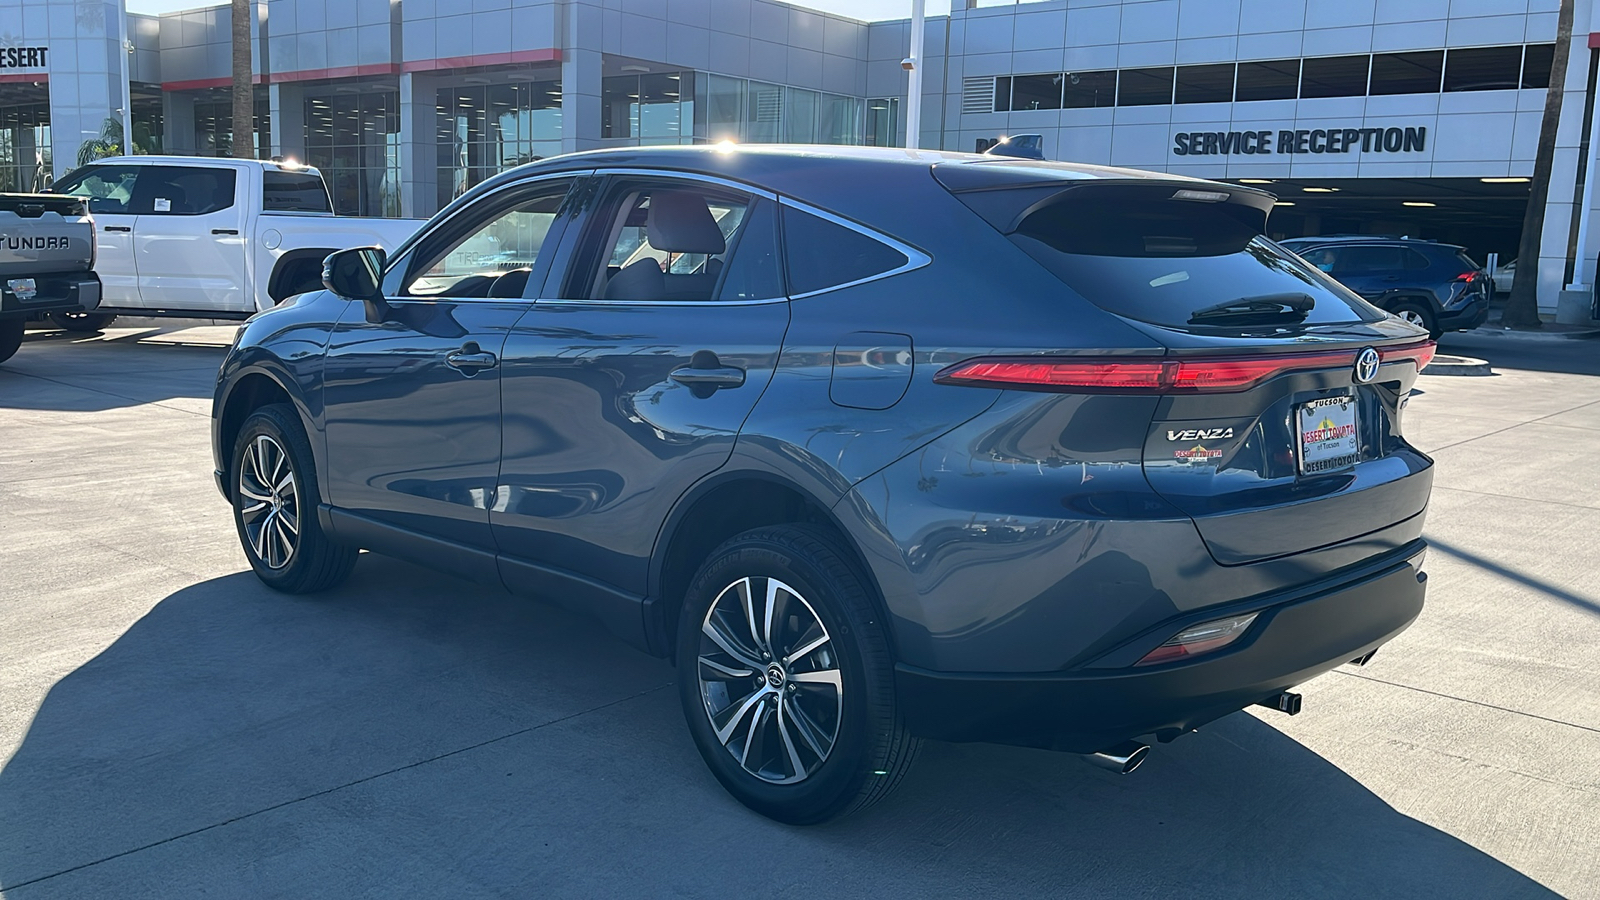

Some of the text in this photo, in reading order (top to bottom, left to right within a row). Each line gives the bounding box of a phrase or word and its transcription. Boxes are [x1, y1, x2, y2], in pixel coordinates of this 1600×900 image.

[0, 47, 48, 68] ESERT
[1173, 126, 1426, 156] SERVICE RECEPTION
[1314, 397, 1344, 408] TUCSON
[1167, 427, 1234, 441] VENZA
[1302, 424, 1355, 444] DESERT TOYOTA
[1323, 442, 1340, 450] Tucson
[1306, 454, 1360, 473] DESERT TOYOTA
